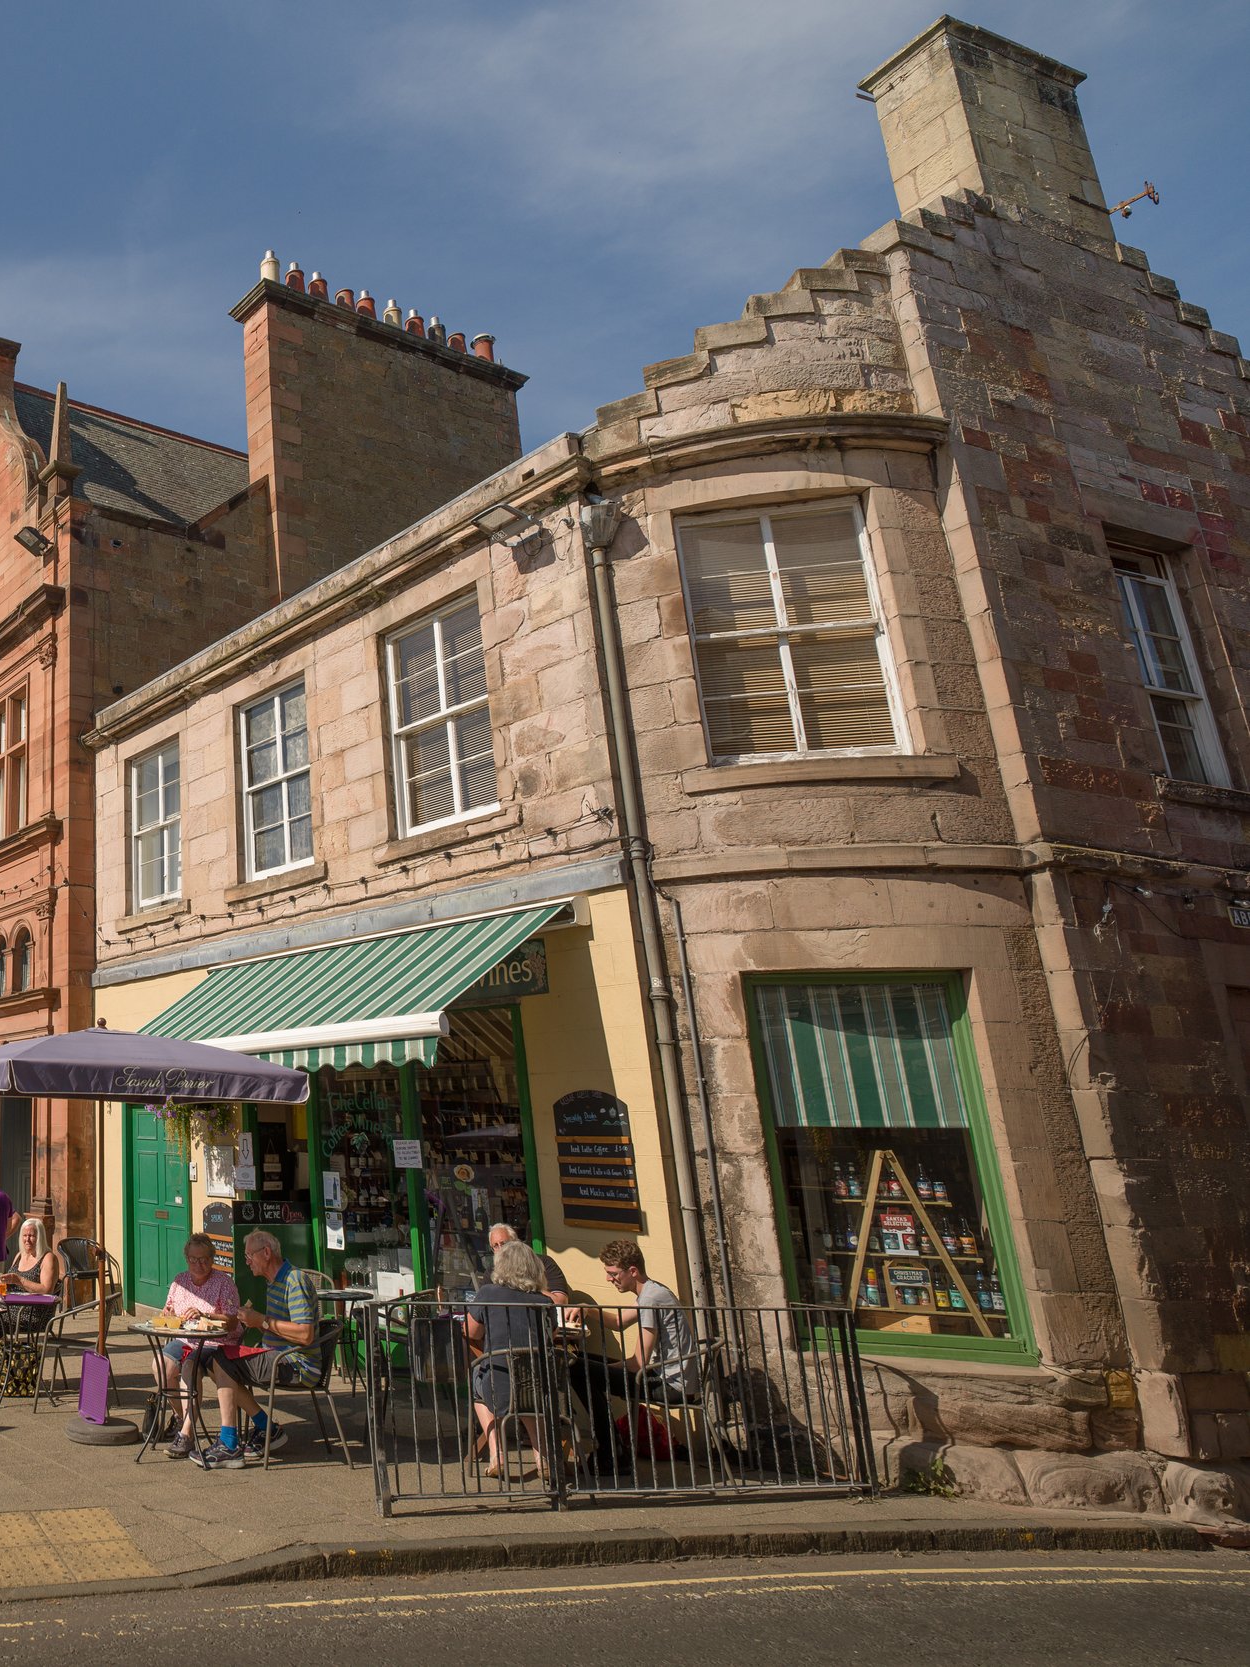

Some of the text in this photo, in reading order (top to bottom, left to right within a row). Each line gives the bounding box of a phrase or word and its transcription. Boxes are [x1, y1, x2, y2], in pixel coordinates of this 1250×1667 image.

[1234, 909, 1250, 925] AB
[479, 960, 532, 987] ines
[115, 1066, 215, 1092] Joseph Perrier
[354, 1089, 389, 1110] Cellar
[322, 1121, 352, 1157] Coffee
[594, 1145, 609, 1155] Coffee
